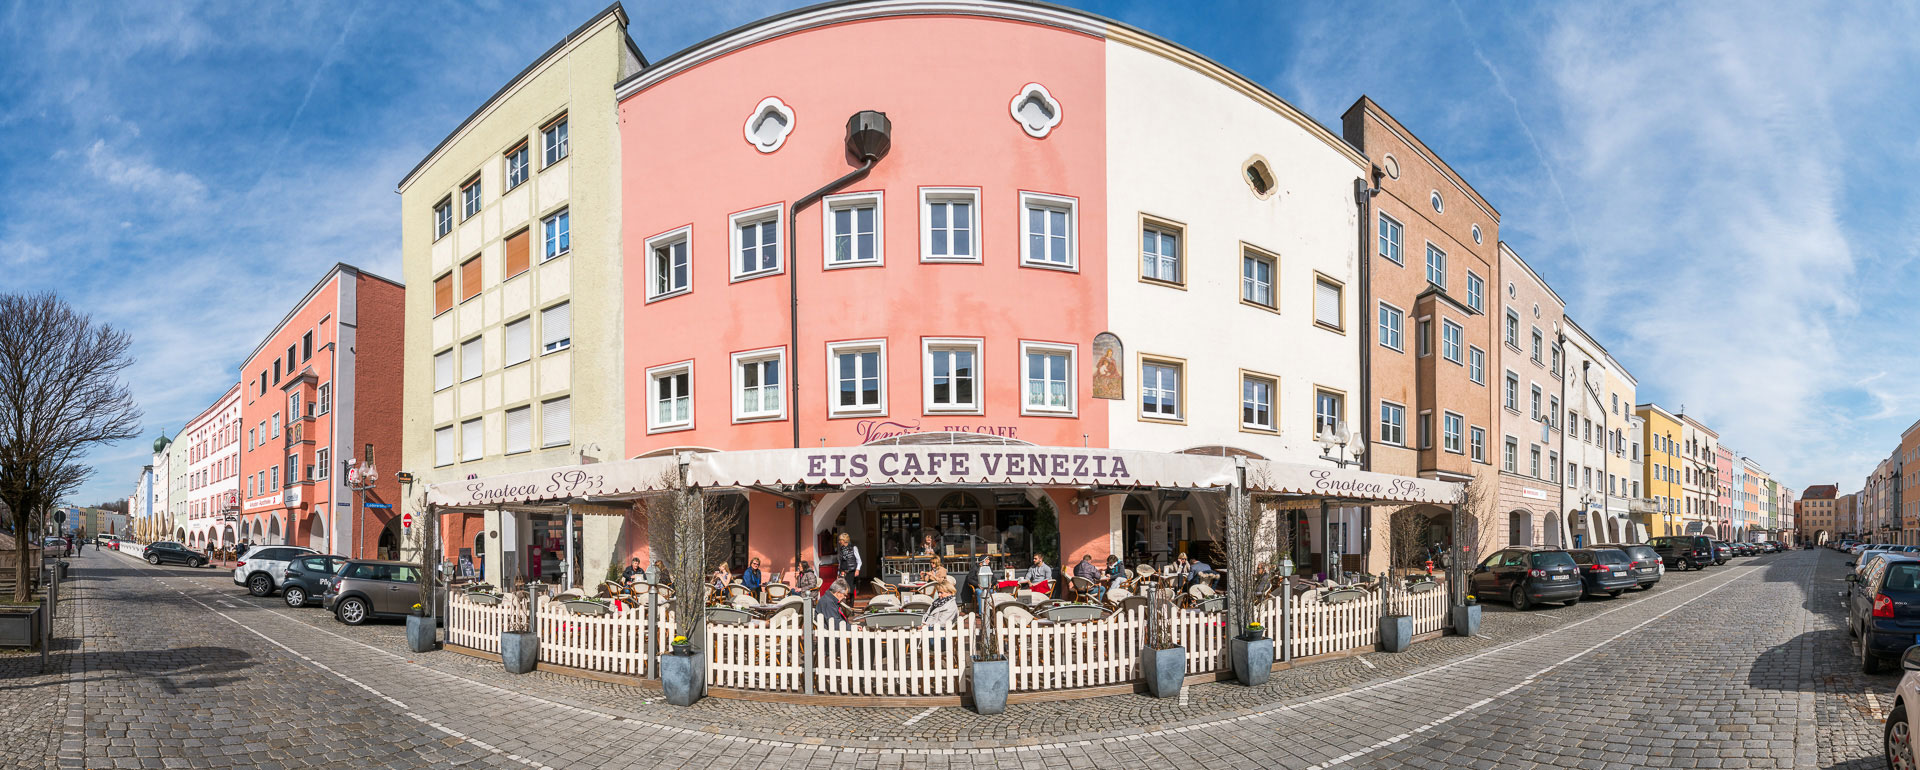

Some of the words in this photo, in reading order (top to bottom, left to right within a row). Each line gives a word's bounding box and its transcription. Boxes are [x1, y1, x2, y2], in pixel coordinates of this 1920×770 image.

[807, 454, 869, 477] EIS
[878, 452, 970, 477] CAFE
[980, 452, 1130, 478] VENEZIA
[466, 482, 539, 501] Enoteca
[546, 470, 604, 493] SP53
[1309, 469, 1384, 494] Enoteca
[1387, 478, 1426, 498] SP53
